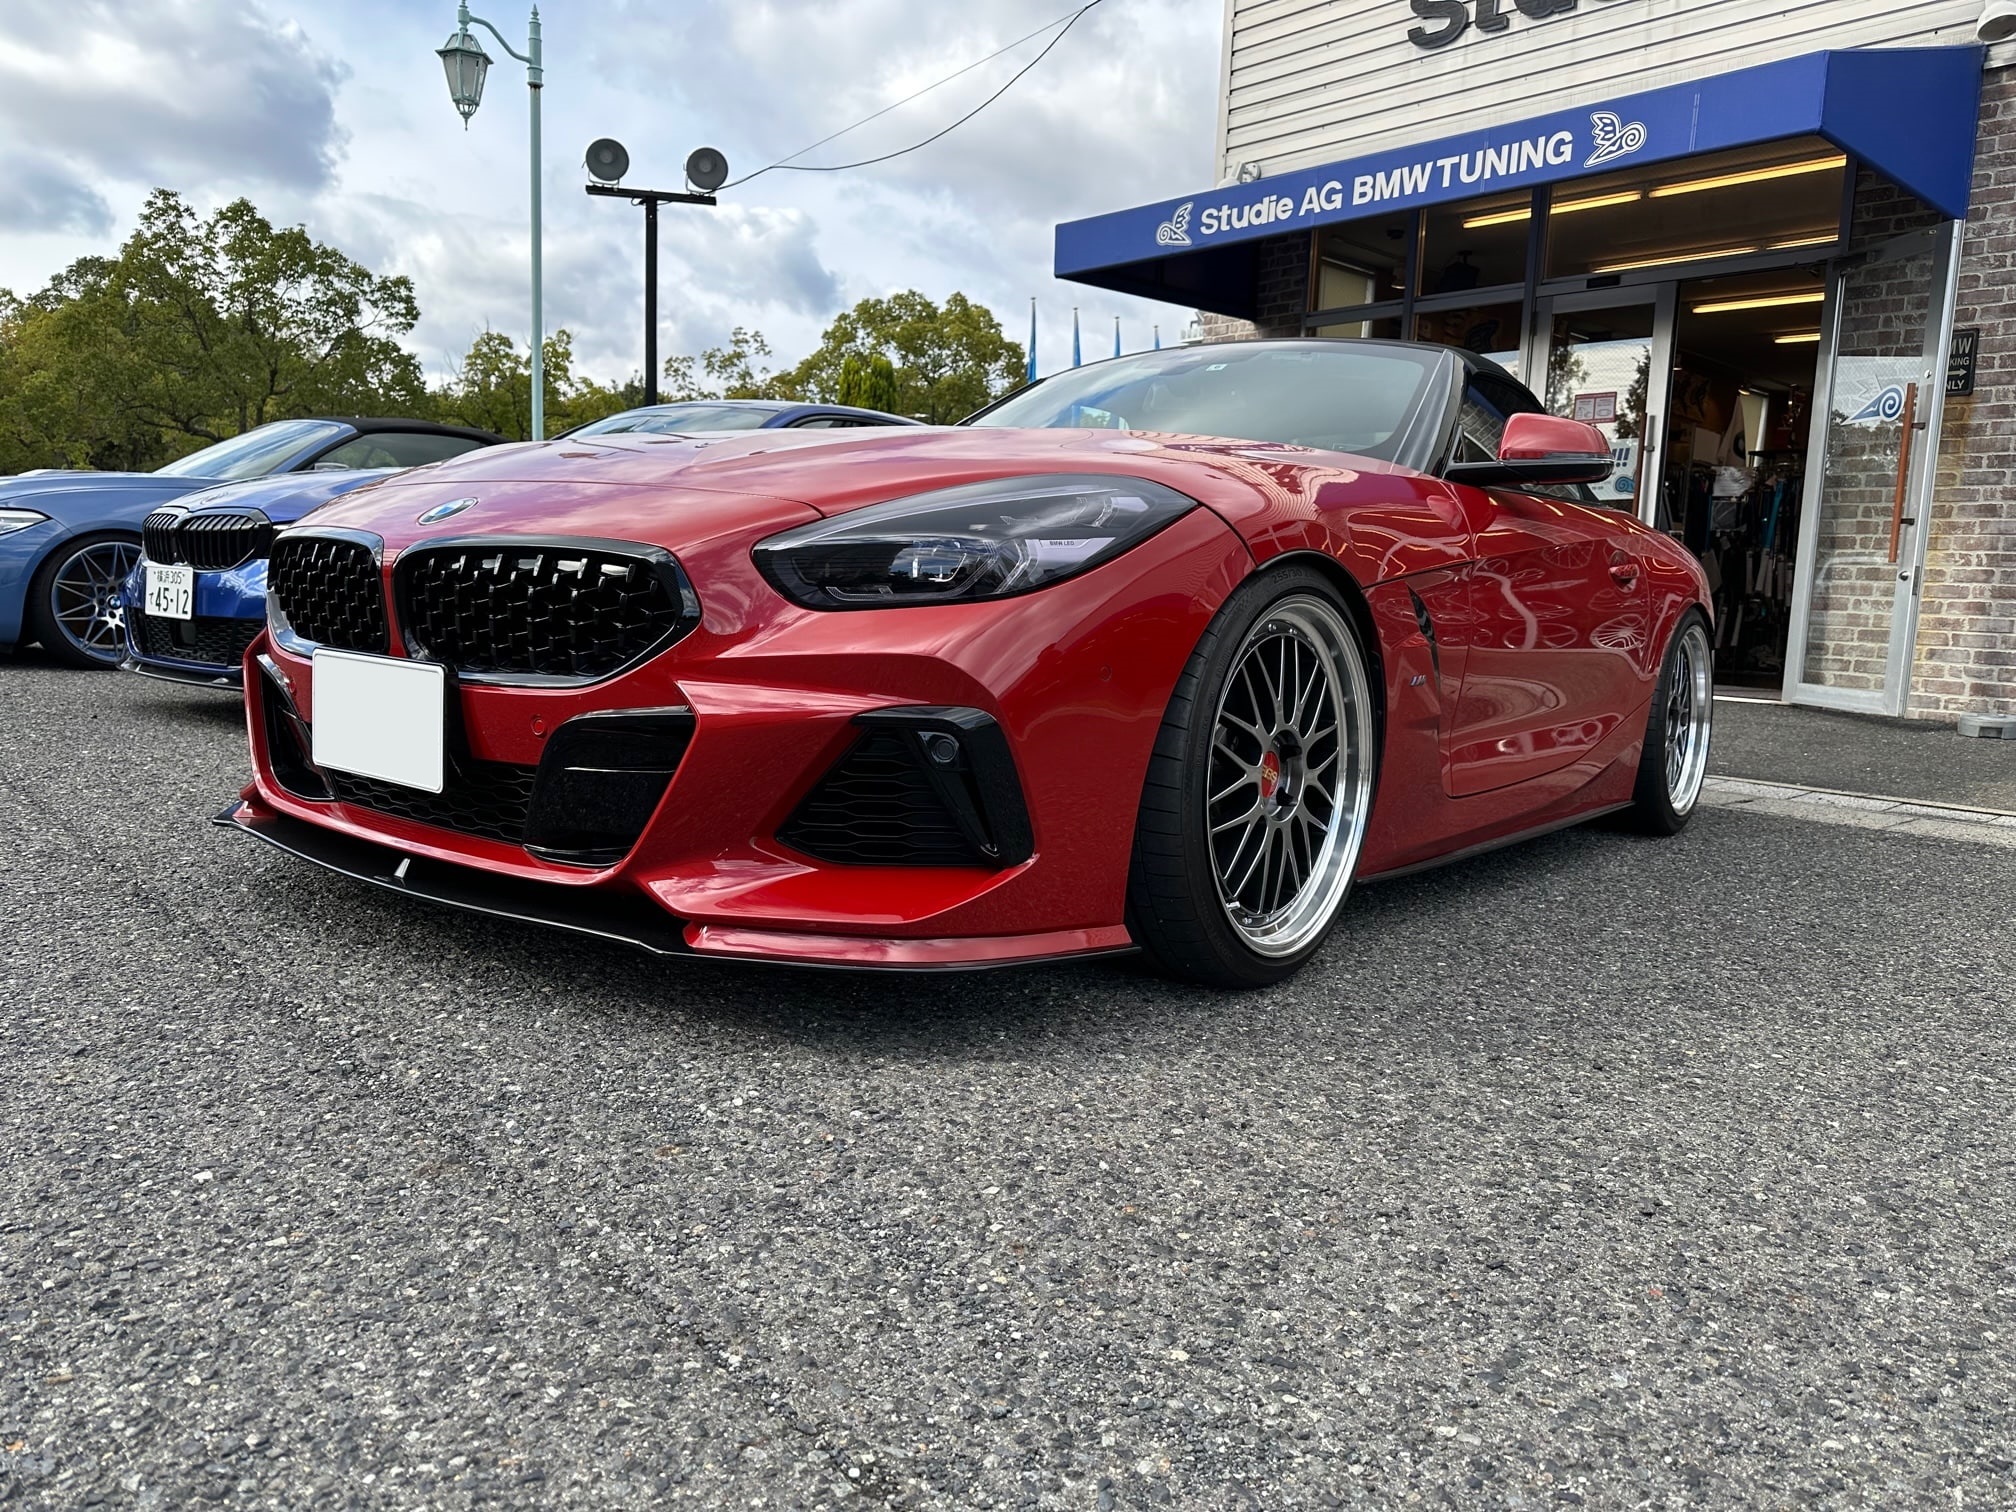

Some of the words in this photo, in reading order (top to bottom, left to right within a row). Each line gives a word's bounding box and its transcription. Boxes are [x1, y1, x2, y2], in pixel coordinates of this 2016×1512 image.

[1200, 194, 1294, 235] Studie
[1298, 181, 1343, 217] AG
[1352, 161, 1434, 206] BMW
[1436, 131, 1573, 188] TUNING
[1950, 357, 1970, 366] KING
[1946, 380, 1965, 390] NLY
